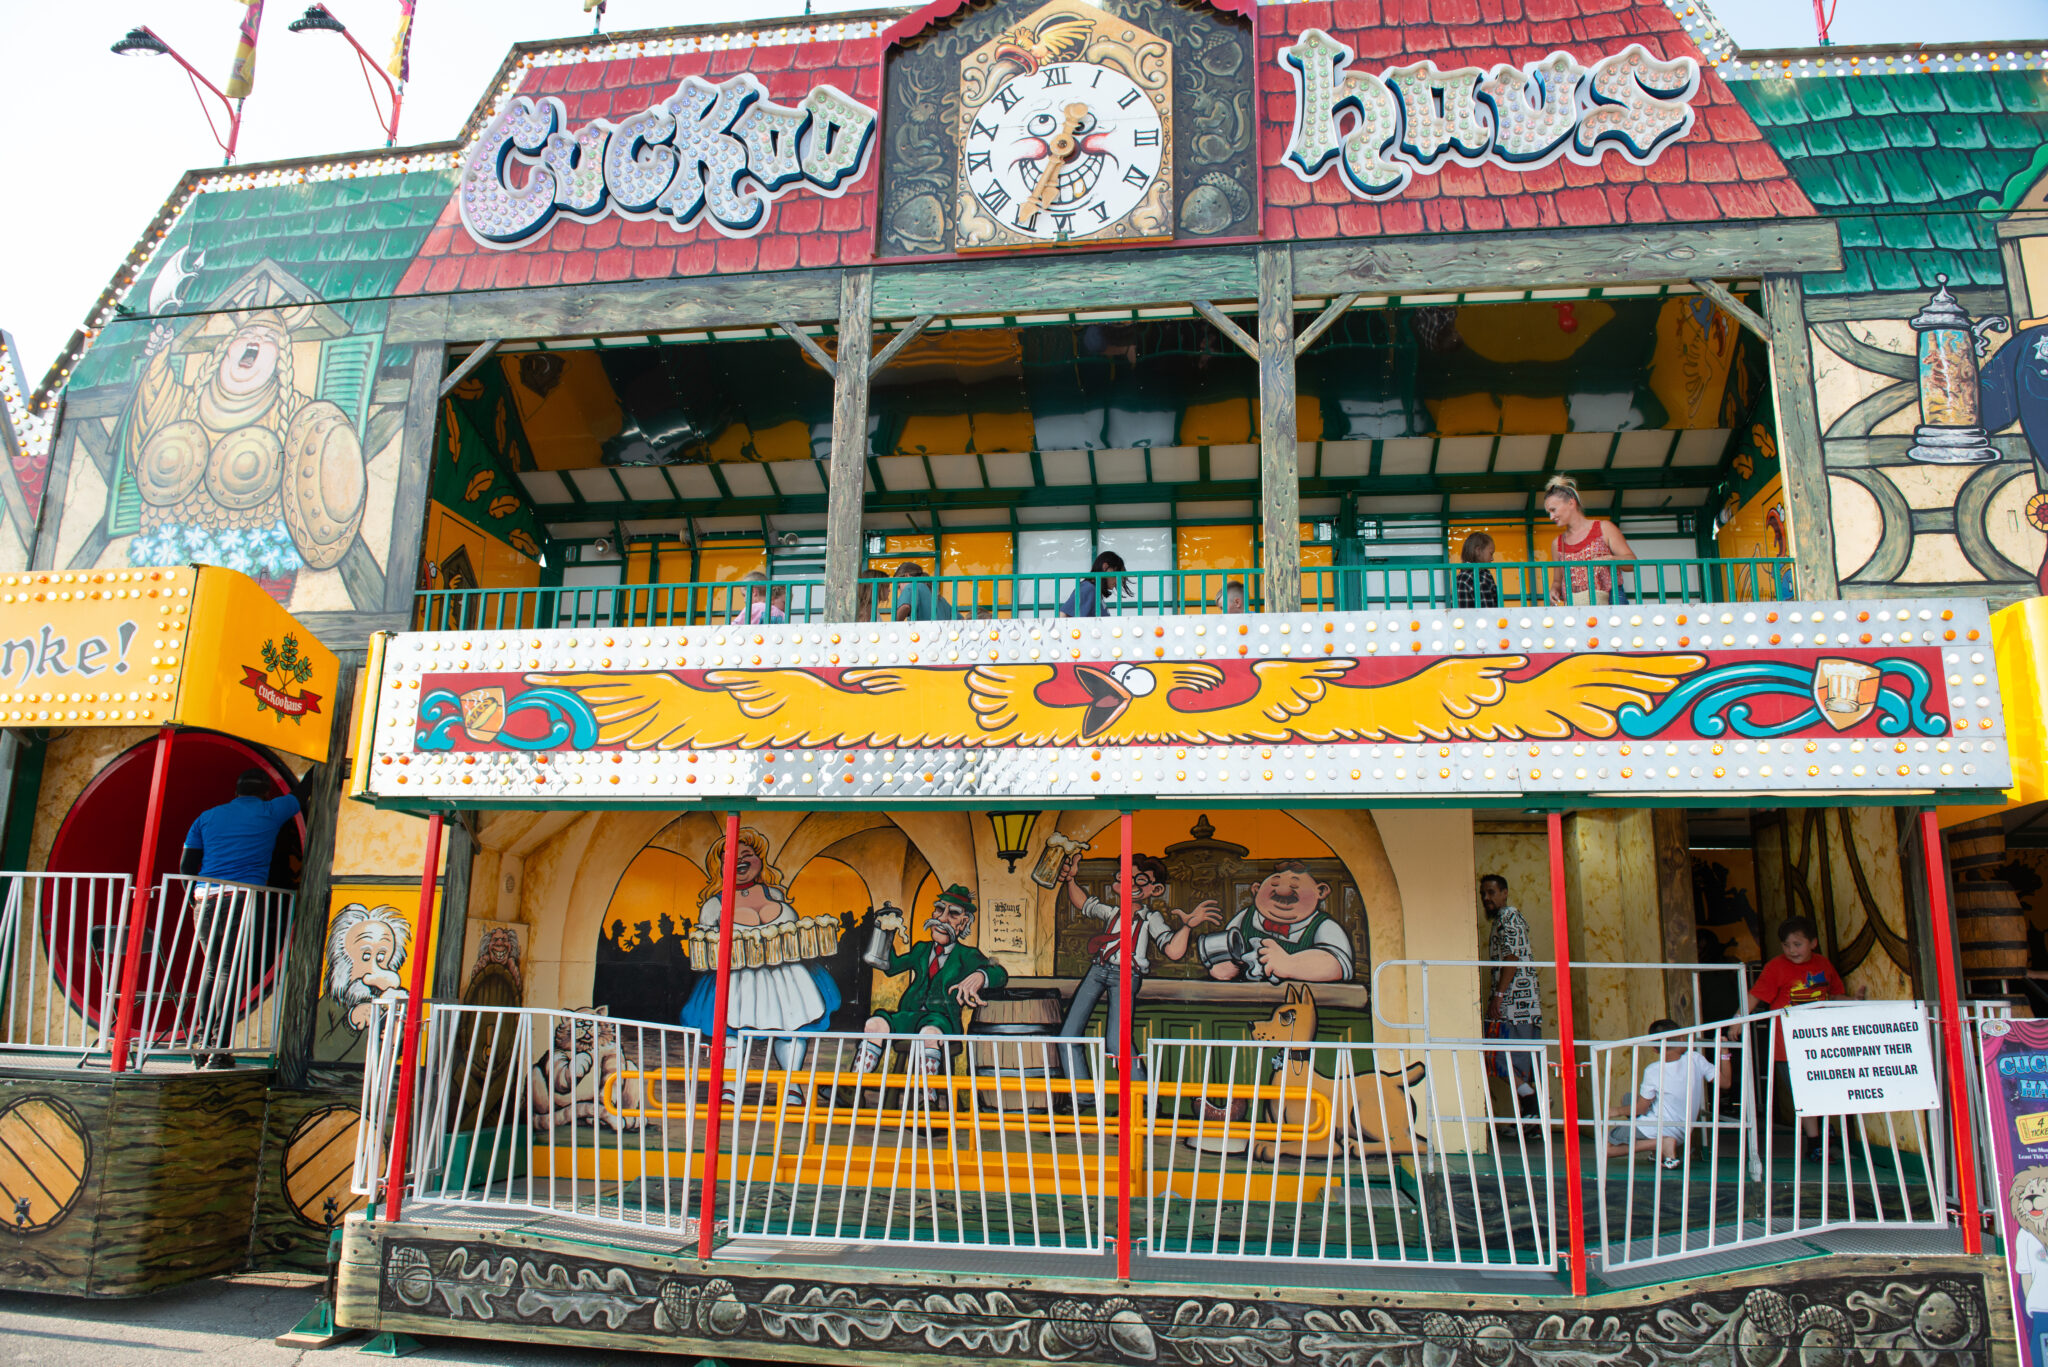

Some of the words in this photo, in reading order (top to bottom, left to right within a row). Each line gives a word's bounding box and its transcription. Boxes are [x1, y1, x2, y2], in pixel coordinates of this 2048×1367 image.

[1040, 66, 1072, 89] XII
[991, 83, 1024, 114] XI
[1117, 88, 1141, 110] II
[970, 119, 999, 141] X
[1134, 128, 1159, 147] III
[1122, 164, 1150, 190] IV
[978, 179, 1011, 216] VIII
[1088, 200, 1110, 223] V
[1051, 213, 1076, 233] VI
[1792, 1027, 1829, 1040] ADULTS
[1831, 1025, 1849, 1037] ARE
[1852, 1021, 1919, 1036] ENCOURAGED
[1805, 1048, 1817, 1060] TO
[1820, 1045, 1881, 1059] ACCOMPANY
[1883, 1043, 1912, 1055] THEIR
[1806, 1068, 1856, 1081] CHILDREN
[1858, 1067, 1870, 1078] AT
[1872, 1064, 1918, 1077] REGULAR
[2000, 1055, 2048, 1076] CUC
[1847, 1087, 1884, 1100] PRICES
